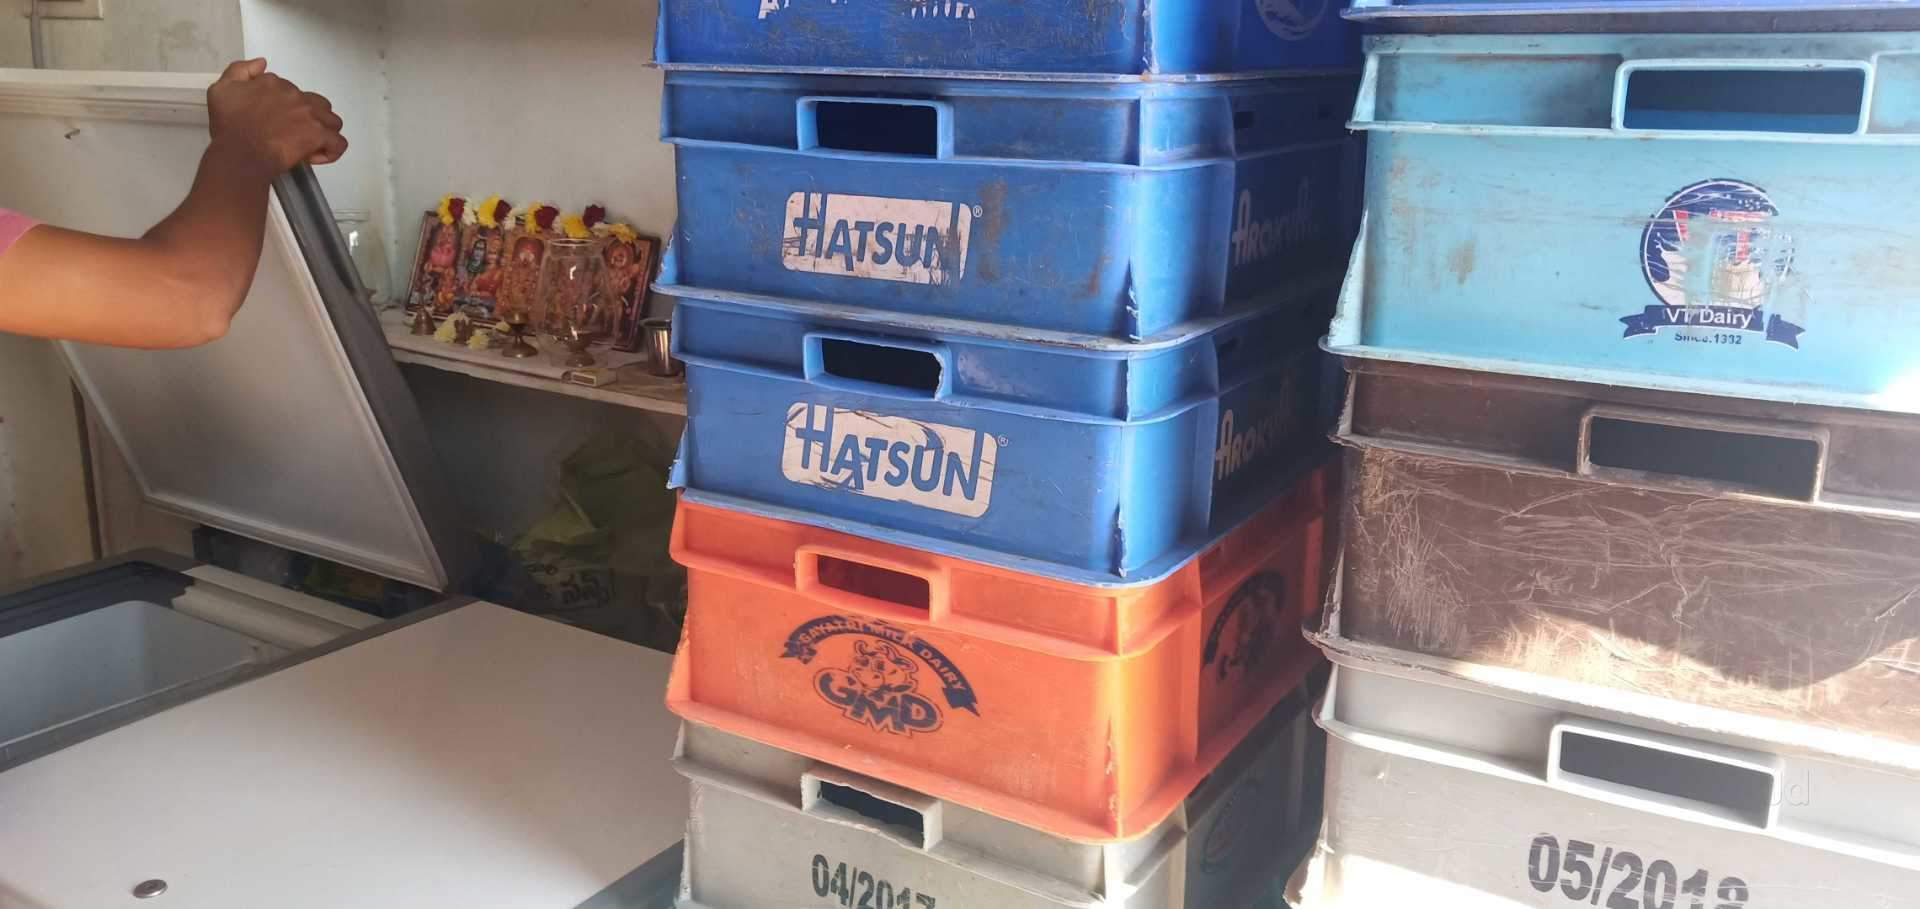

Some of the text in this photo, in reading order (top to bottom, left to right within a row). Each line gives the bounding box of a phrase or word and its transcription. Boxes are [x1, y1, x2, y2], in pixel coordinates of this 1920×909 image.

[793, 192, 961, 287] HATSUN
[1666, 307, 1753, 329] VT Dairy
[795, 403, 985, 501] HATSUN
[816, 670, 940, 734] GMD
[918, 649, 967, 691] DAIRY
